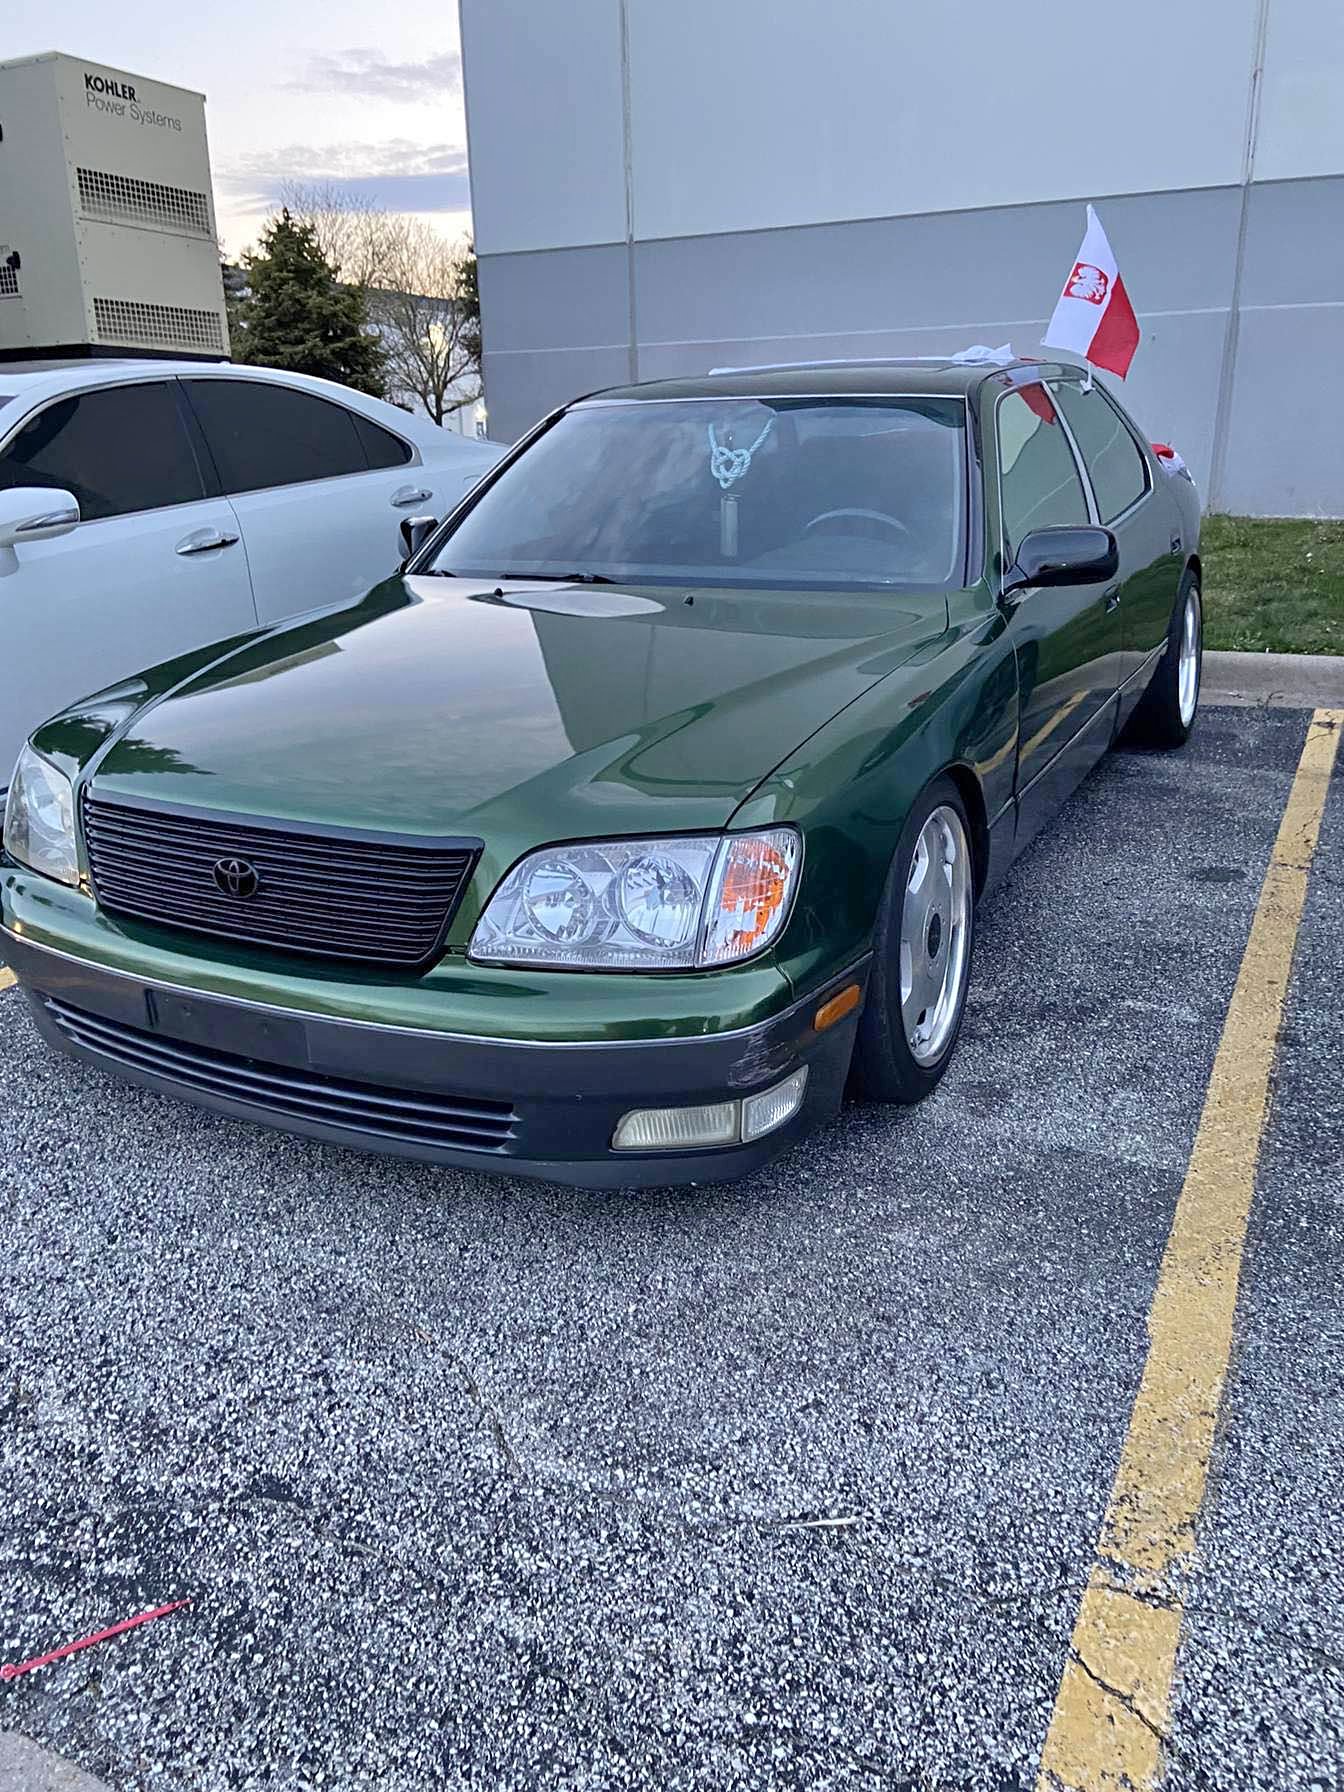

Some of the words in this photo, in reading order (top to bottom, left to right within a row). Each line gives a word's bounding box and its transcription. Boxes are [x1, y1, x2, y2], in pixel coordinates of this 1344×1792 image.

[84, 73, 137, 102] KOHLER
[86, 91, 125, 116] Power
[129, 103, 182, 131] Systems
